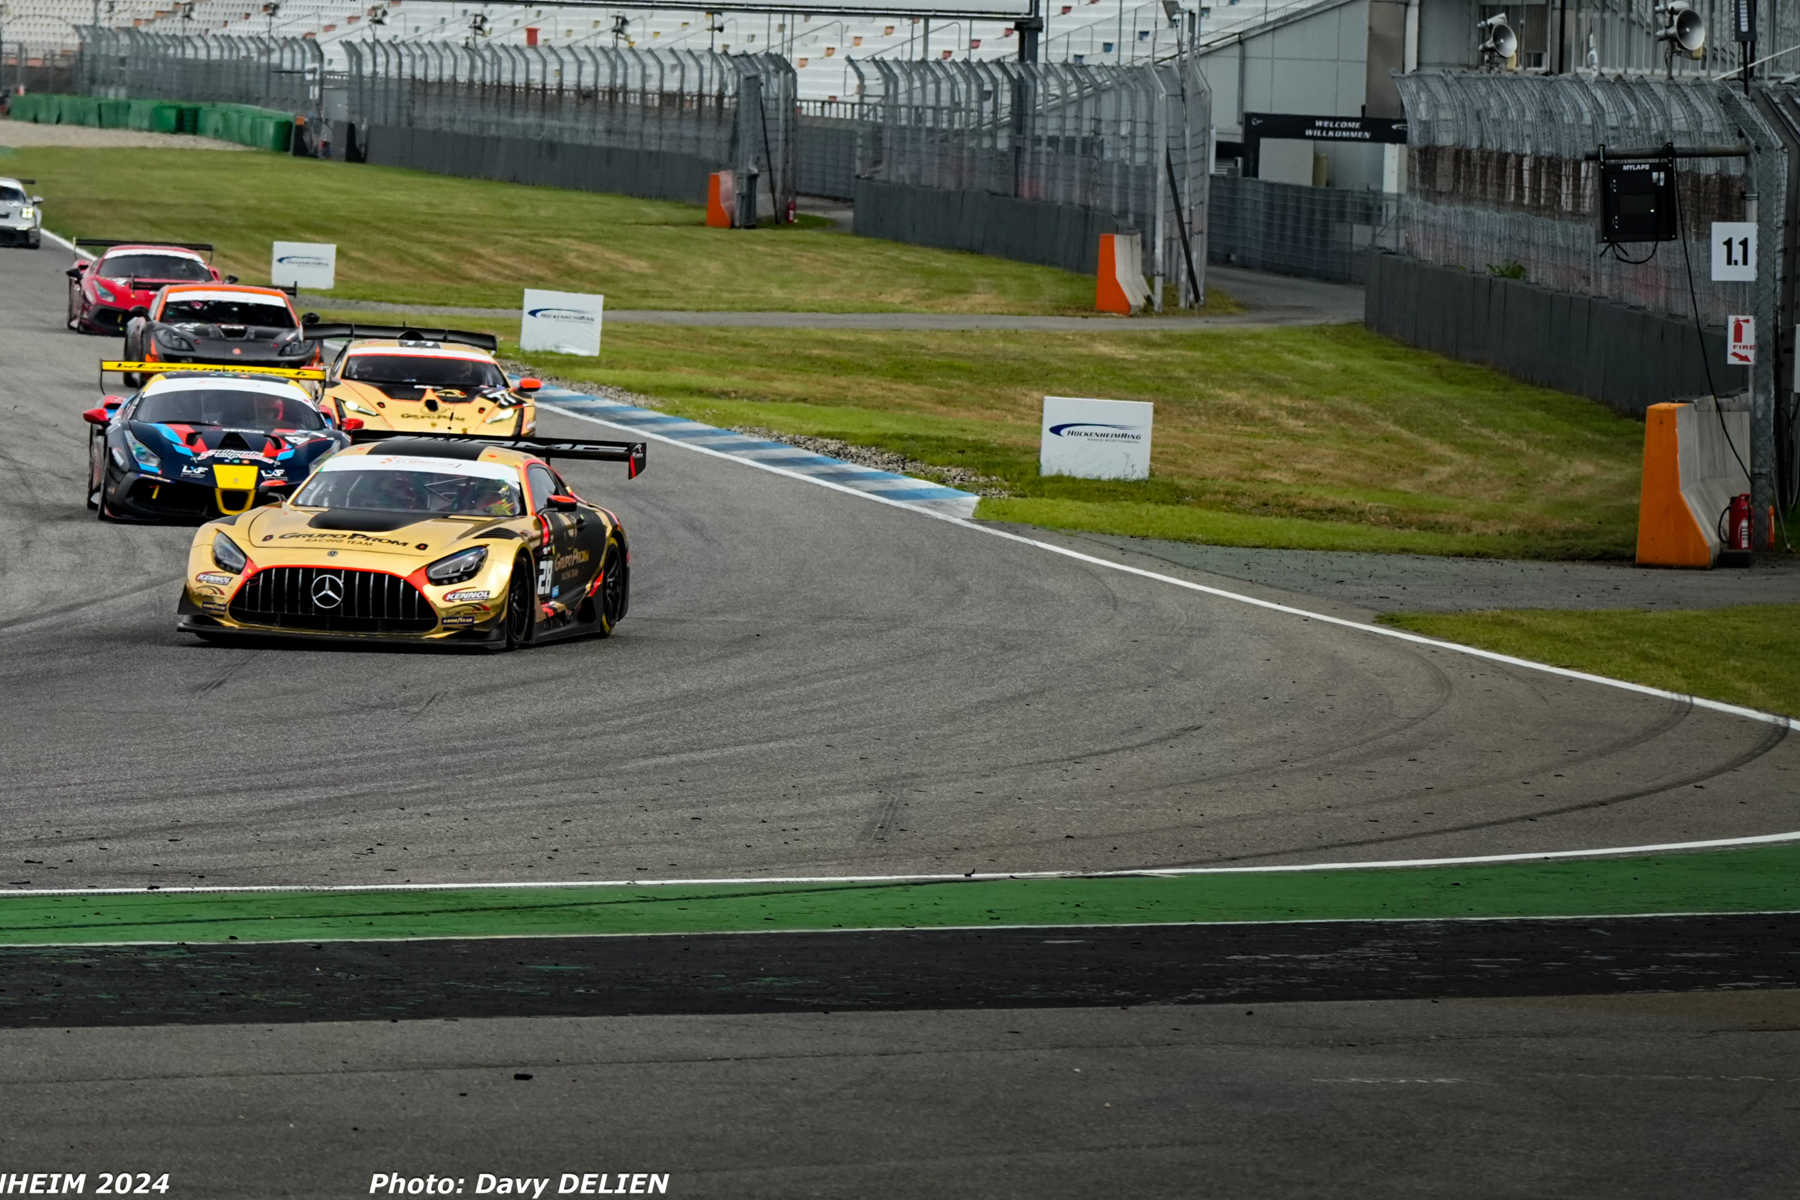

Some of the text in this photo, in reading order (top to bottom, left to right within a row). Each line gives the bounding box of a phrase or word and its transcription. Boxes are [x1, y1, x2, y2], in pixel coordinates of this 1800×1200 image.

[1315, 119, 1361, 129] WELCOME
[1305, 129, 1372, 139] WILLKOMMEN
[1622, 163, 1650, 171] MYLAPS
[1722, 237, 1749, 267] 1.1
[1732, 343, 1757, 351] FIRE
[278, 531, 409, 547] GRUPO PROM
[537, 559, 554, 595] 28
[445, 590, 491, 601] KENNOL
